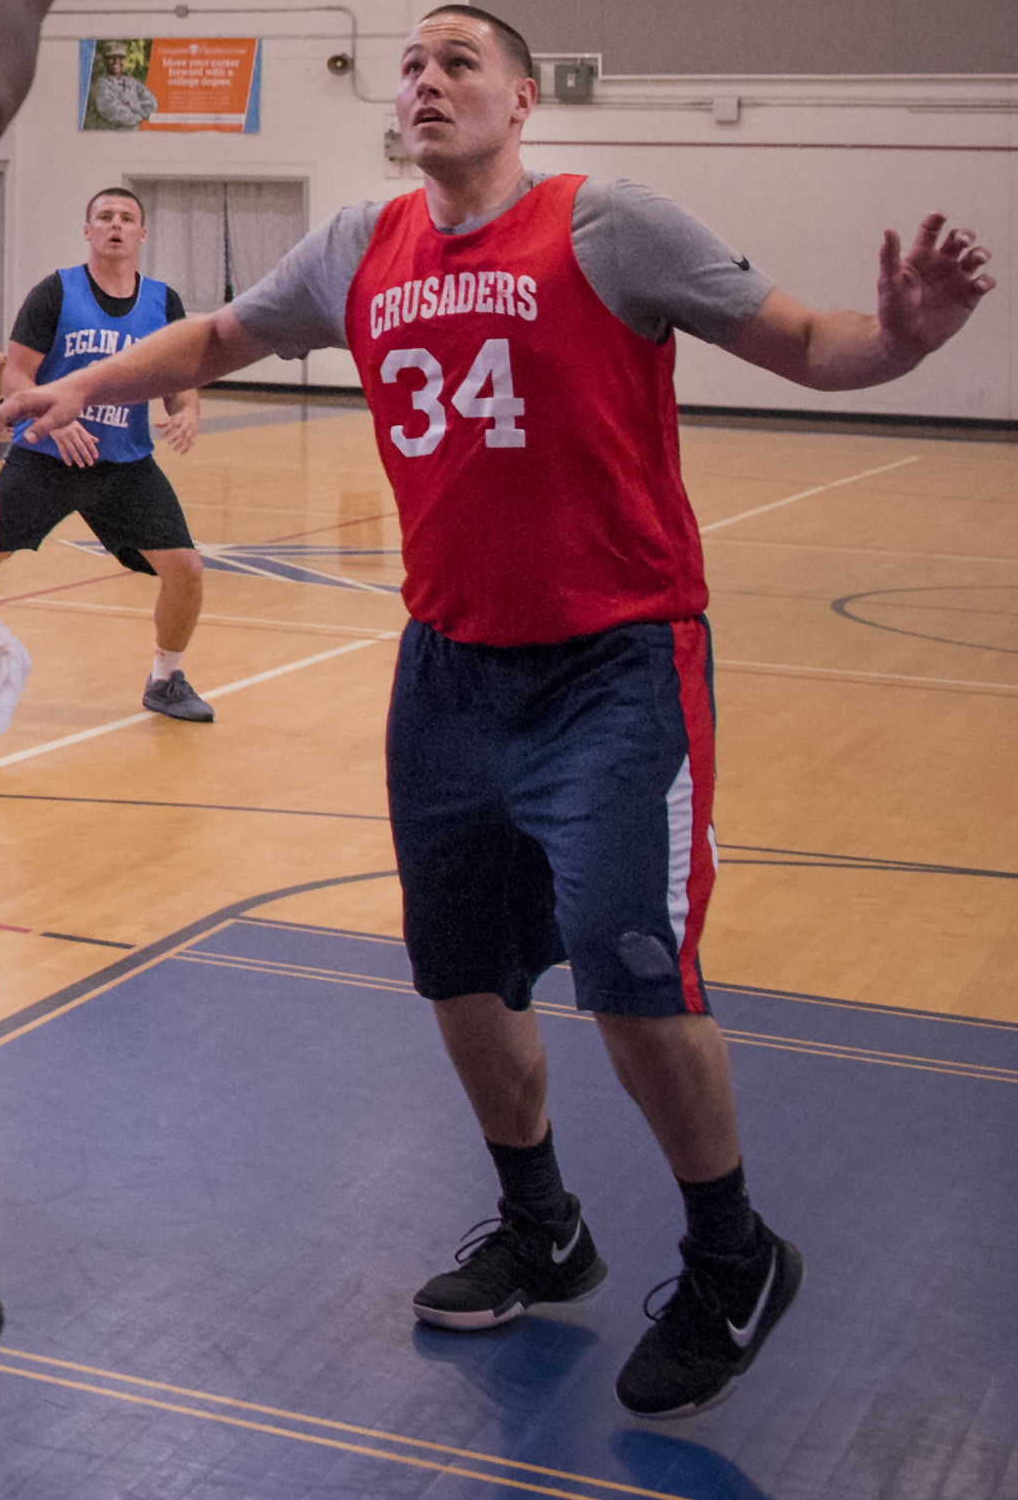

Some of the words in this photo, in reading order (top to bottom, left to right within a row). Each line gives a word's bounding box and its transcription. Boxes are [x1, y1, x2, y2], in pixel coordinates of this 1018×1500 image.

[162, 58, 187, 67] Move
[189, 60, 209, 68] your
[211, 59, 239, 67] career
[168, 67, 203, 77] forward
[205, 67, 225, 76] with
[167, 76, 199, 88] college
[370, 271, 538, 339] CRUSADERS
[64, 329, 119, 357] EGLIN
[380, 338, 526, 458] 34
